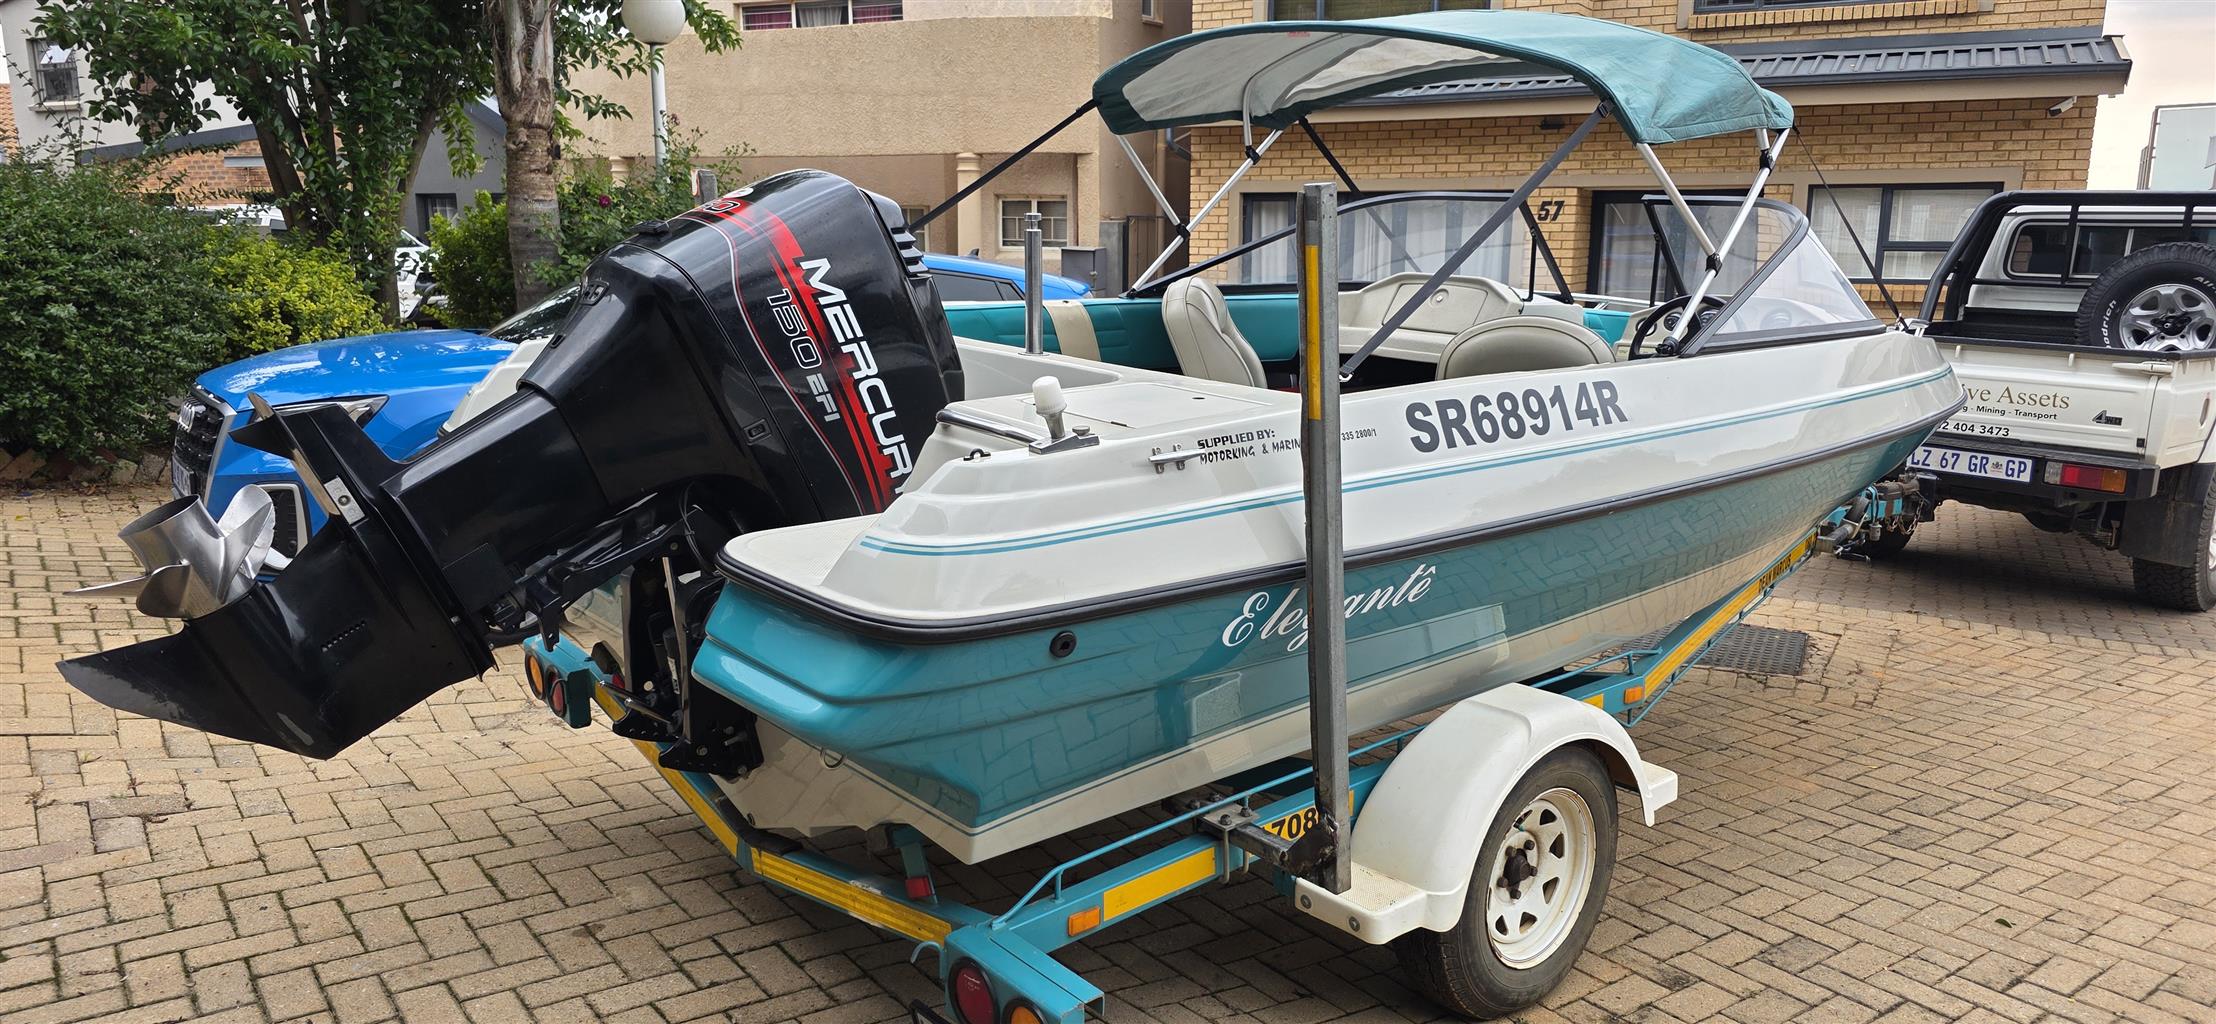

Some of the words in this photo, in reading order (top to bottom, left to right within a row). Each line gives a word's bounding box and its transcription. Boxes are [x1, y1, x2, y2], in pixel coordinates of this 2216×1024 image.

[1537, 200, 1565, 221] 57
[766, 288, 823, 370] 150
[806, 373, 840, 422] EFI
[799, 257, 913, 494] MERCUR
[1997, 386, 2070, 409] Assets
[1405, 380, 1628, 453] SR68914R
[1976, 405, 2006, 416] Mining
[2014, 408, 2057, 421] Transport
[1197, 431, 1255, 450] SUPPLIED
[1256, 428, 1276, 440] BY:
[1953, 422, 1975, 433] 404
[1979, 425, 2010, 437] 3473
[1200, 445, 1256, 464] MOTORKING
[1262, 442, 1269, 454] &
[1940, 451, 1960, 470] 67
[1968, 454, 1990, 474] GR
[2005, 459, 2028, 479] GP
